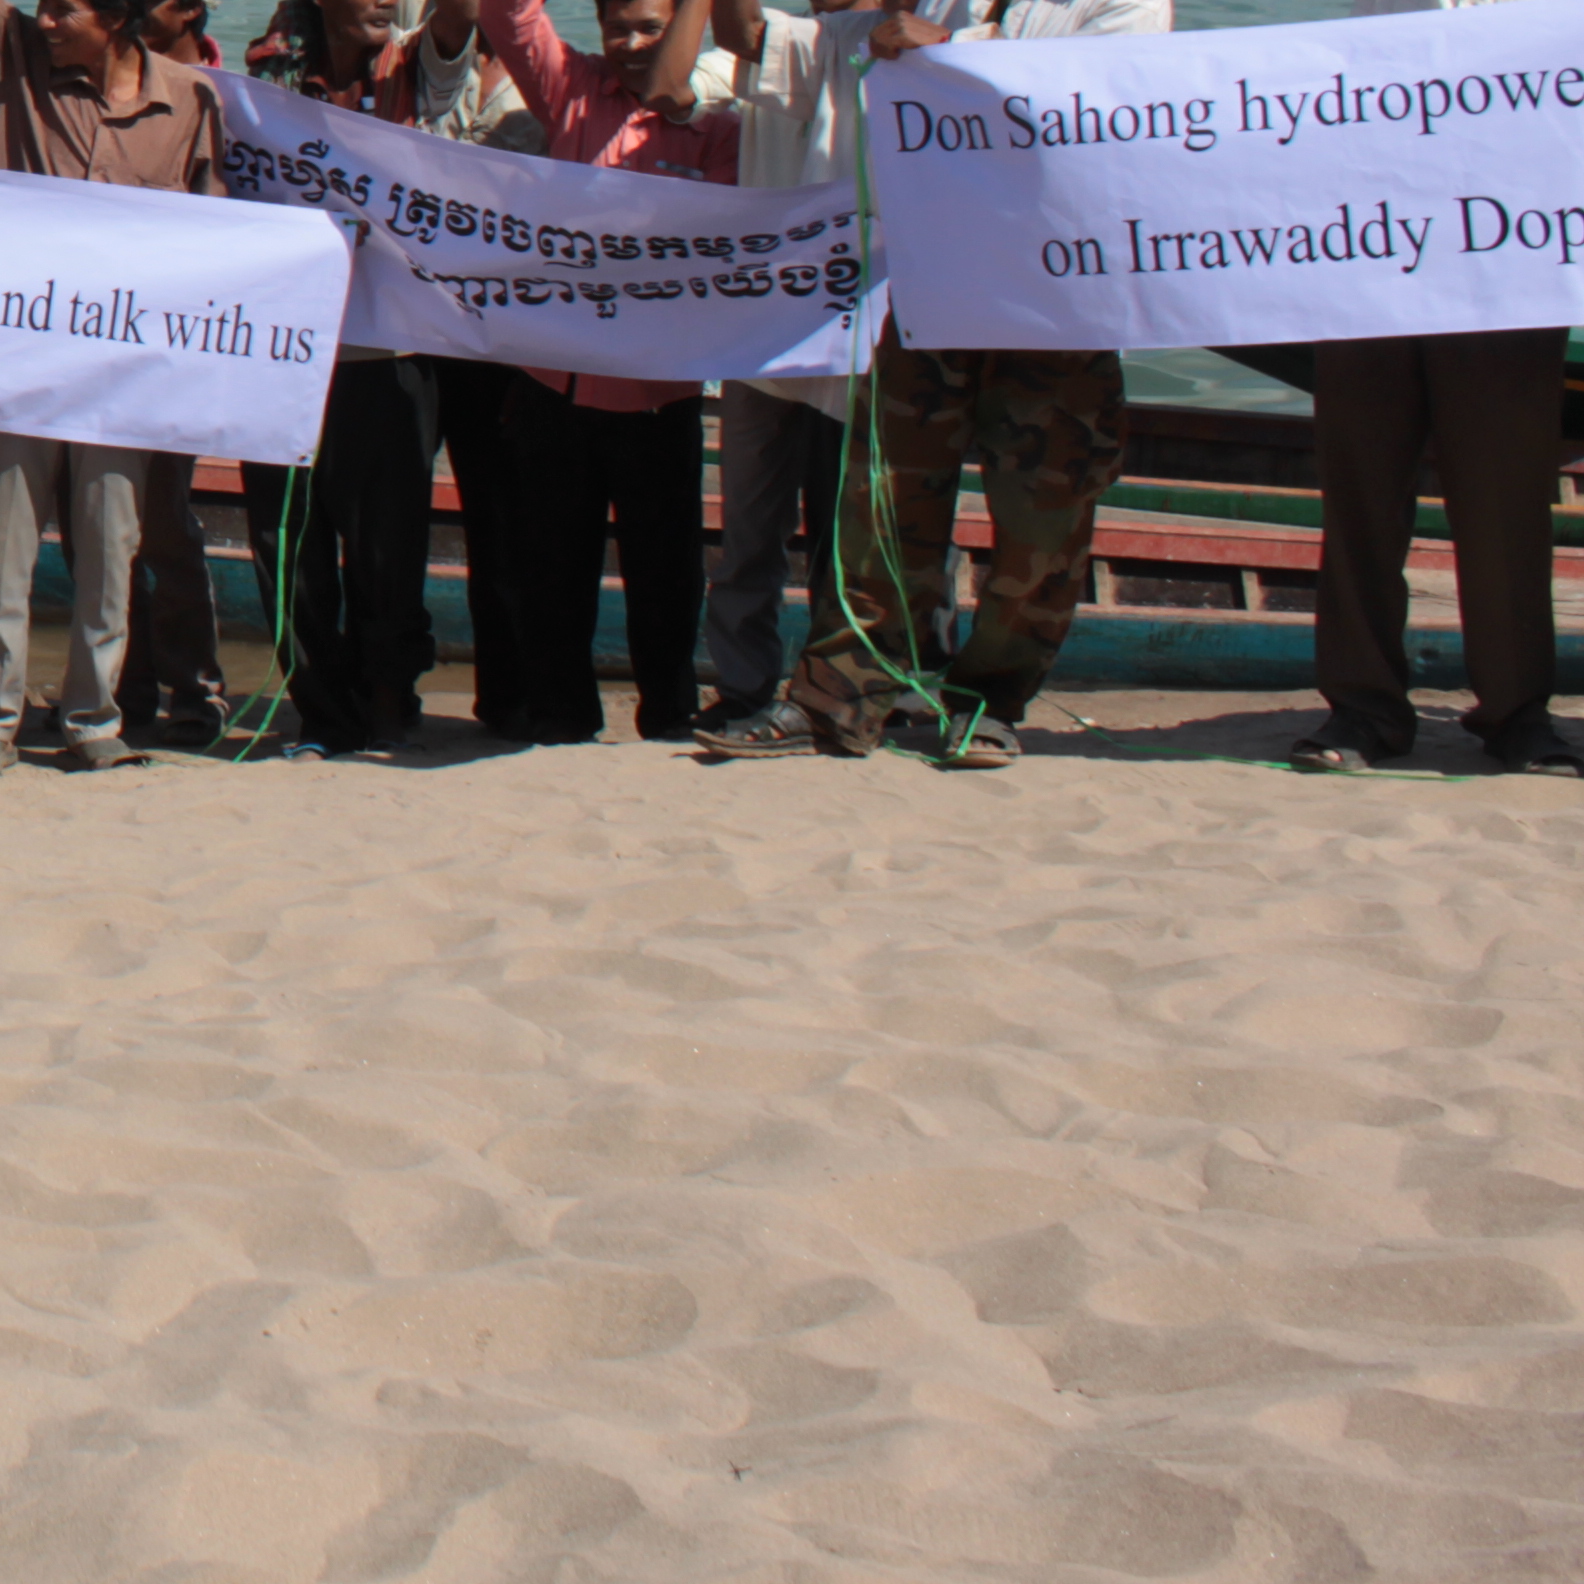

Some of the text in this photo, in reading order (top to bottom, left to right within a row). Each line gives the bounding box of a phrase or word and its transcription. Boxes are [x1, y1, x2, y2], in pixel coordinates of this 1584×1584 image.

[893, 101, 992, 152] Don
[1004, 92, 1216, 152] Sahong
[1042, 239, 1107, 276] on
[1124, 200, 1432, 274] Irrawaddy
[70, 288, 148, 344] talk
[163, 300, 252, 357] with
[270, 326, 314, 363] us
